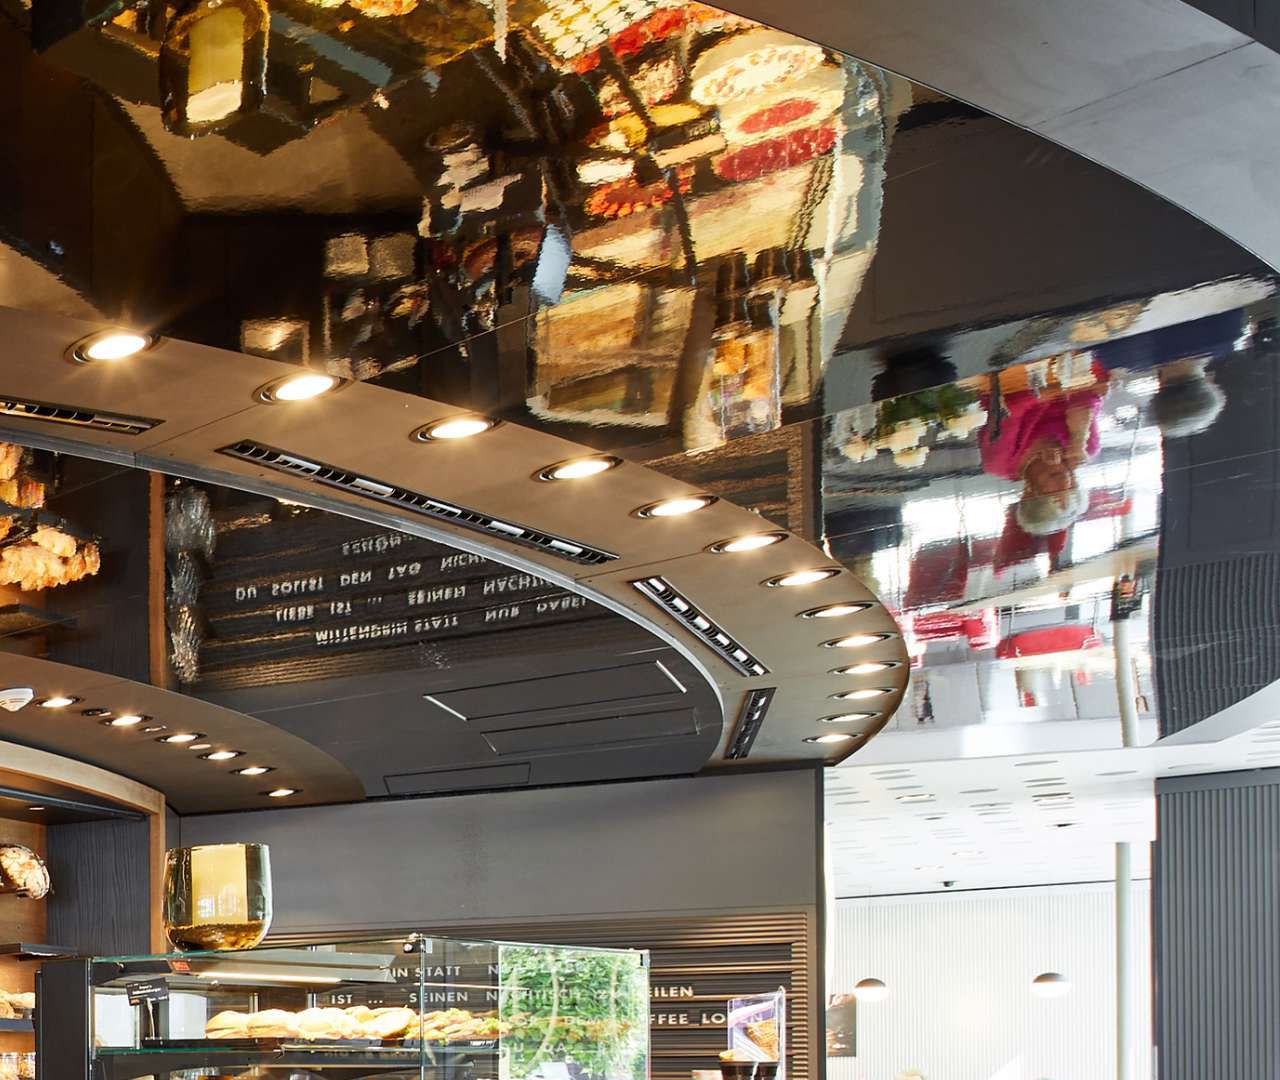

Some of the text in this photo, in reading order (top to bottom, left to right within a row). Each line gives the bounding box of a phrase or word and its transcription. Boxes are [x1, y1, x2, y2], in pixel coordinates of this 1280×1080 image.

[414, 965, 462, 978] STATT
[331, 993, 353, 1005] IST
[408, 991, 469, 1004] SEINEN
[649, 985, 694, 998] EILEN
[649, 1013, 689, 1025] FFEE
